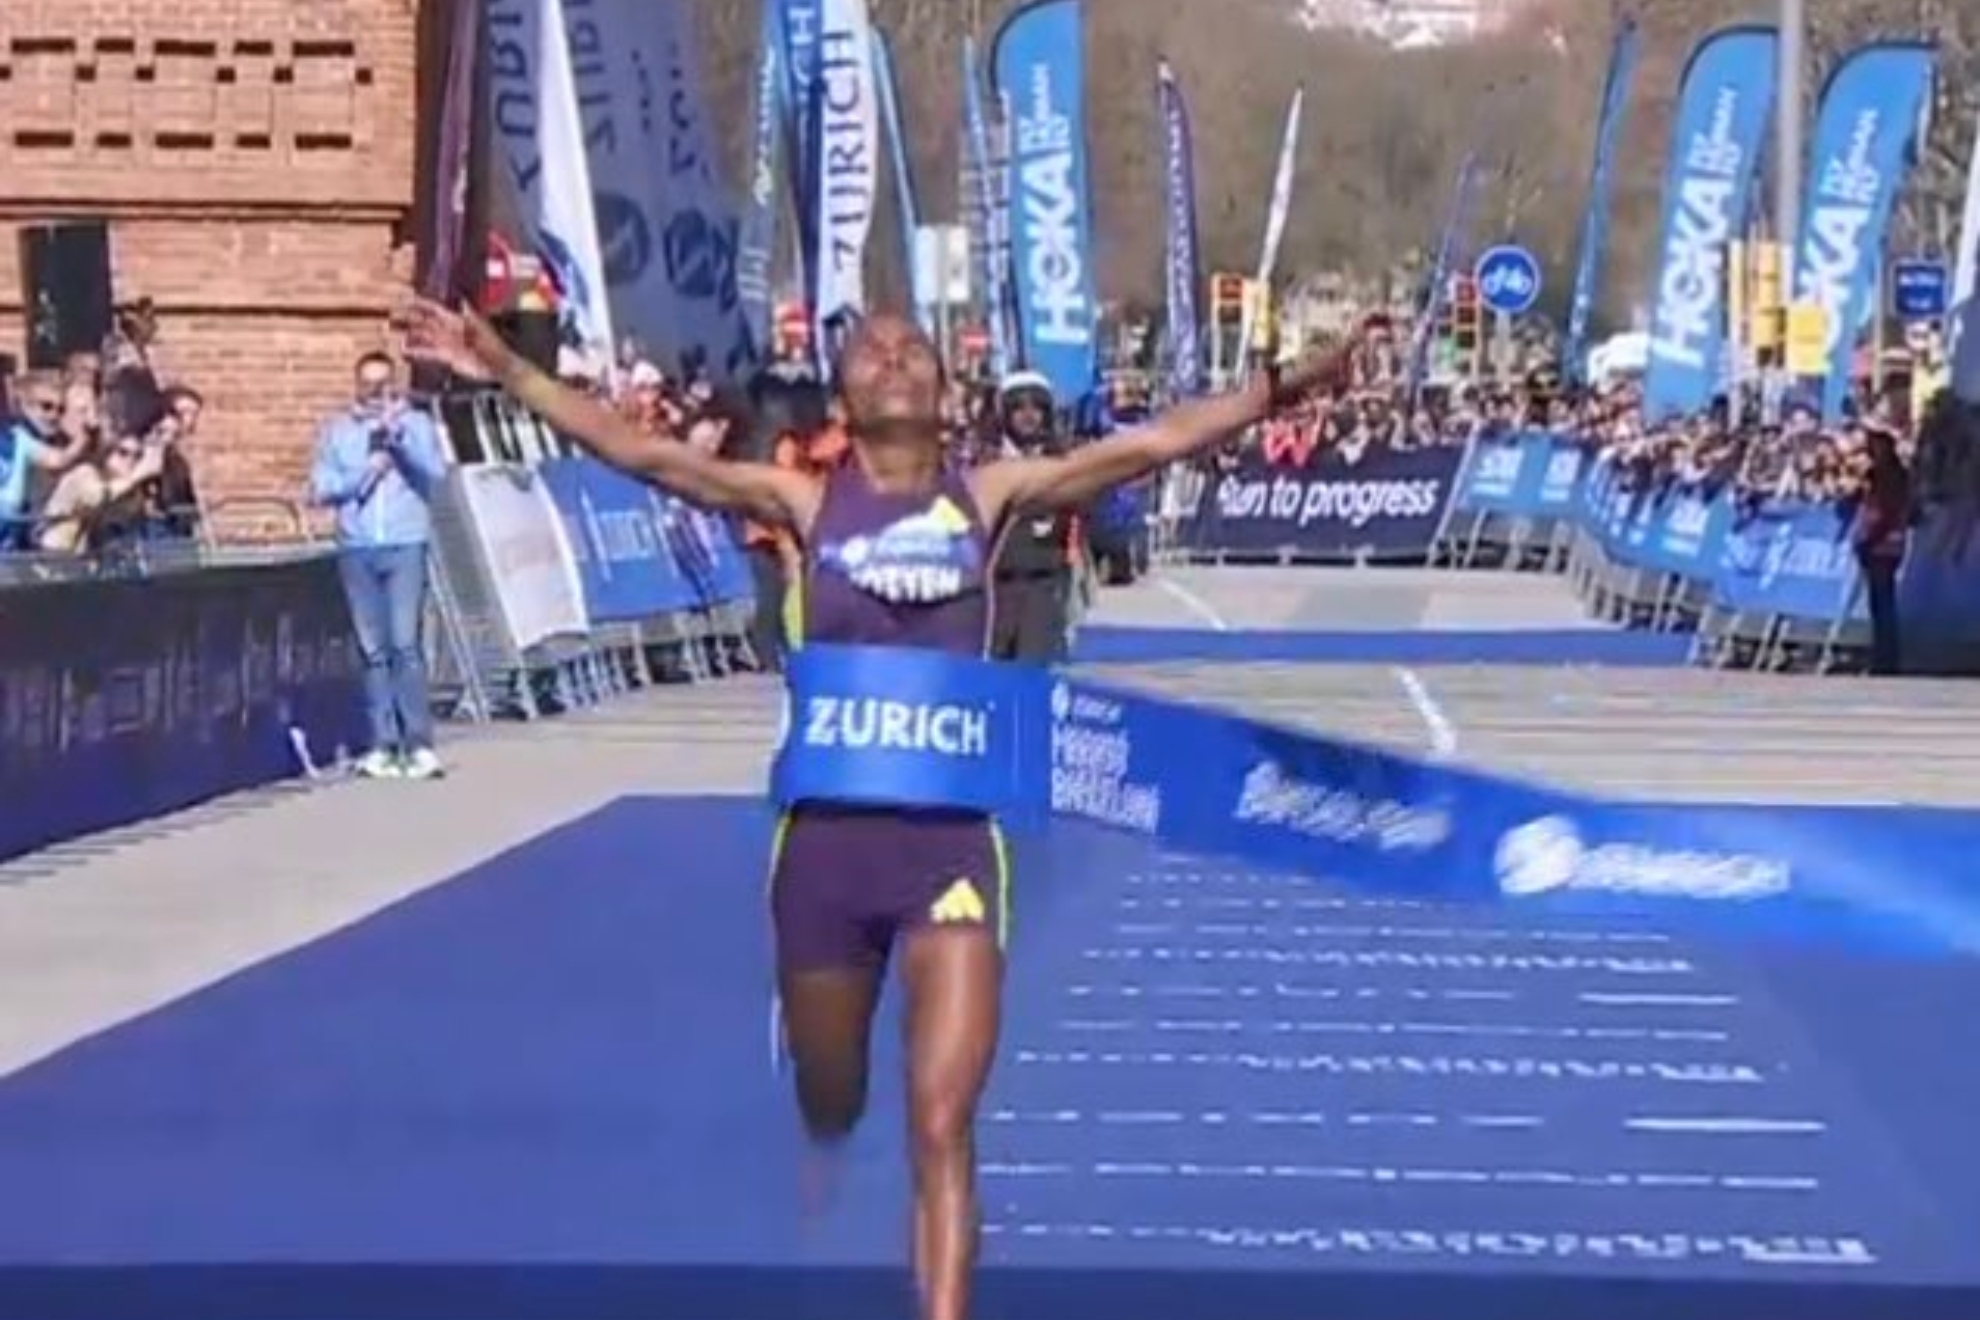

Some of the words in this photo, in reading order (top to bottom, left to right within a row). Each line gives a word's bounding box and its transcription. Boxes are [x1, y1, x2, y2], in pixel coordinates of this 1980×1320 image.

[1017, 149, 1090, 346] HOKA
[1650, 176, 1736, 369] HOKA
[1269, 474, 1302, 518] to
[1297, 479, 1440, 528] progress
[805, 696, 988, 756] ZURICH
